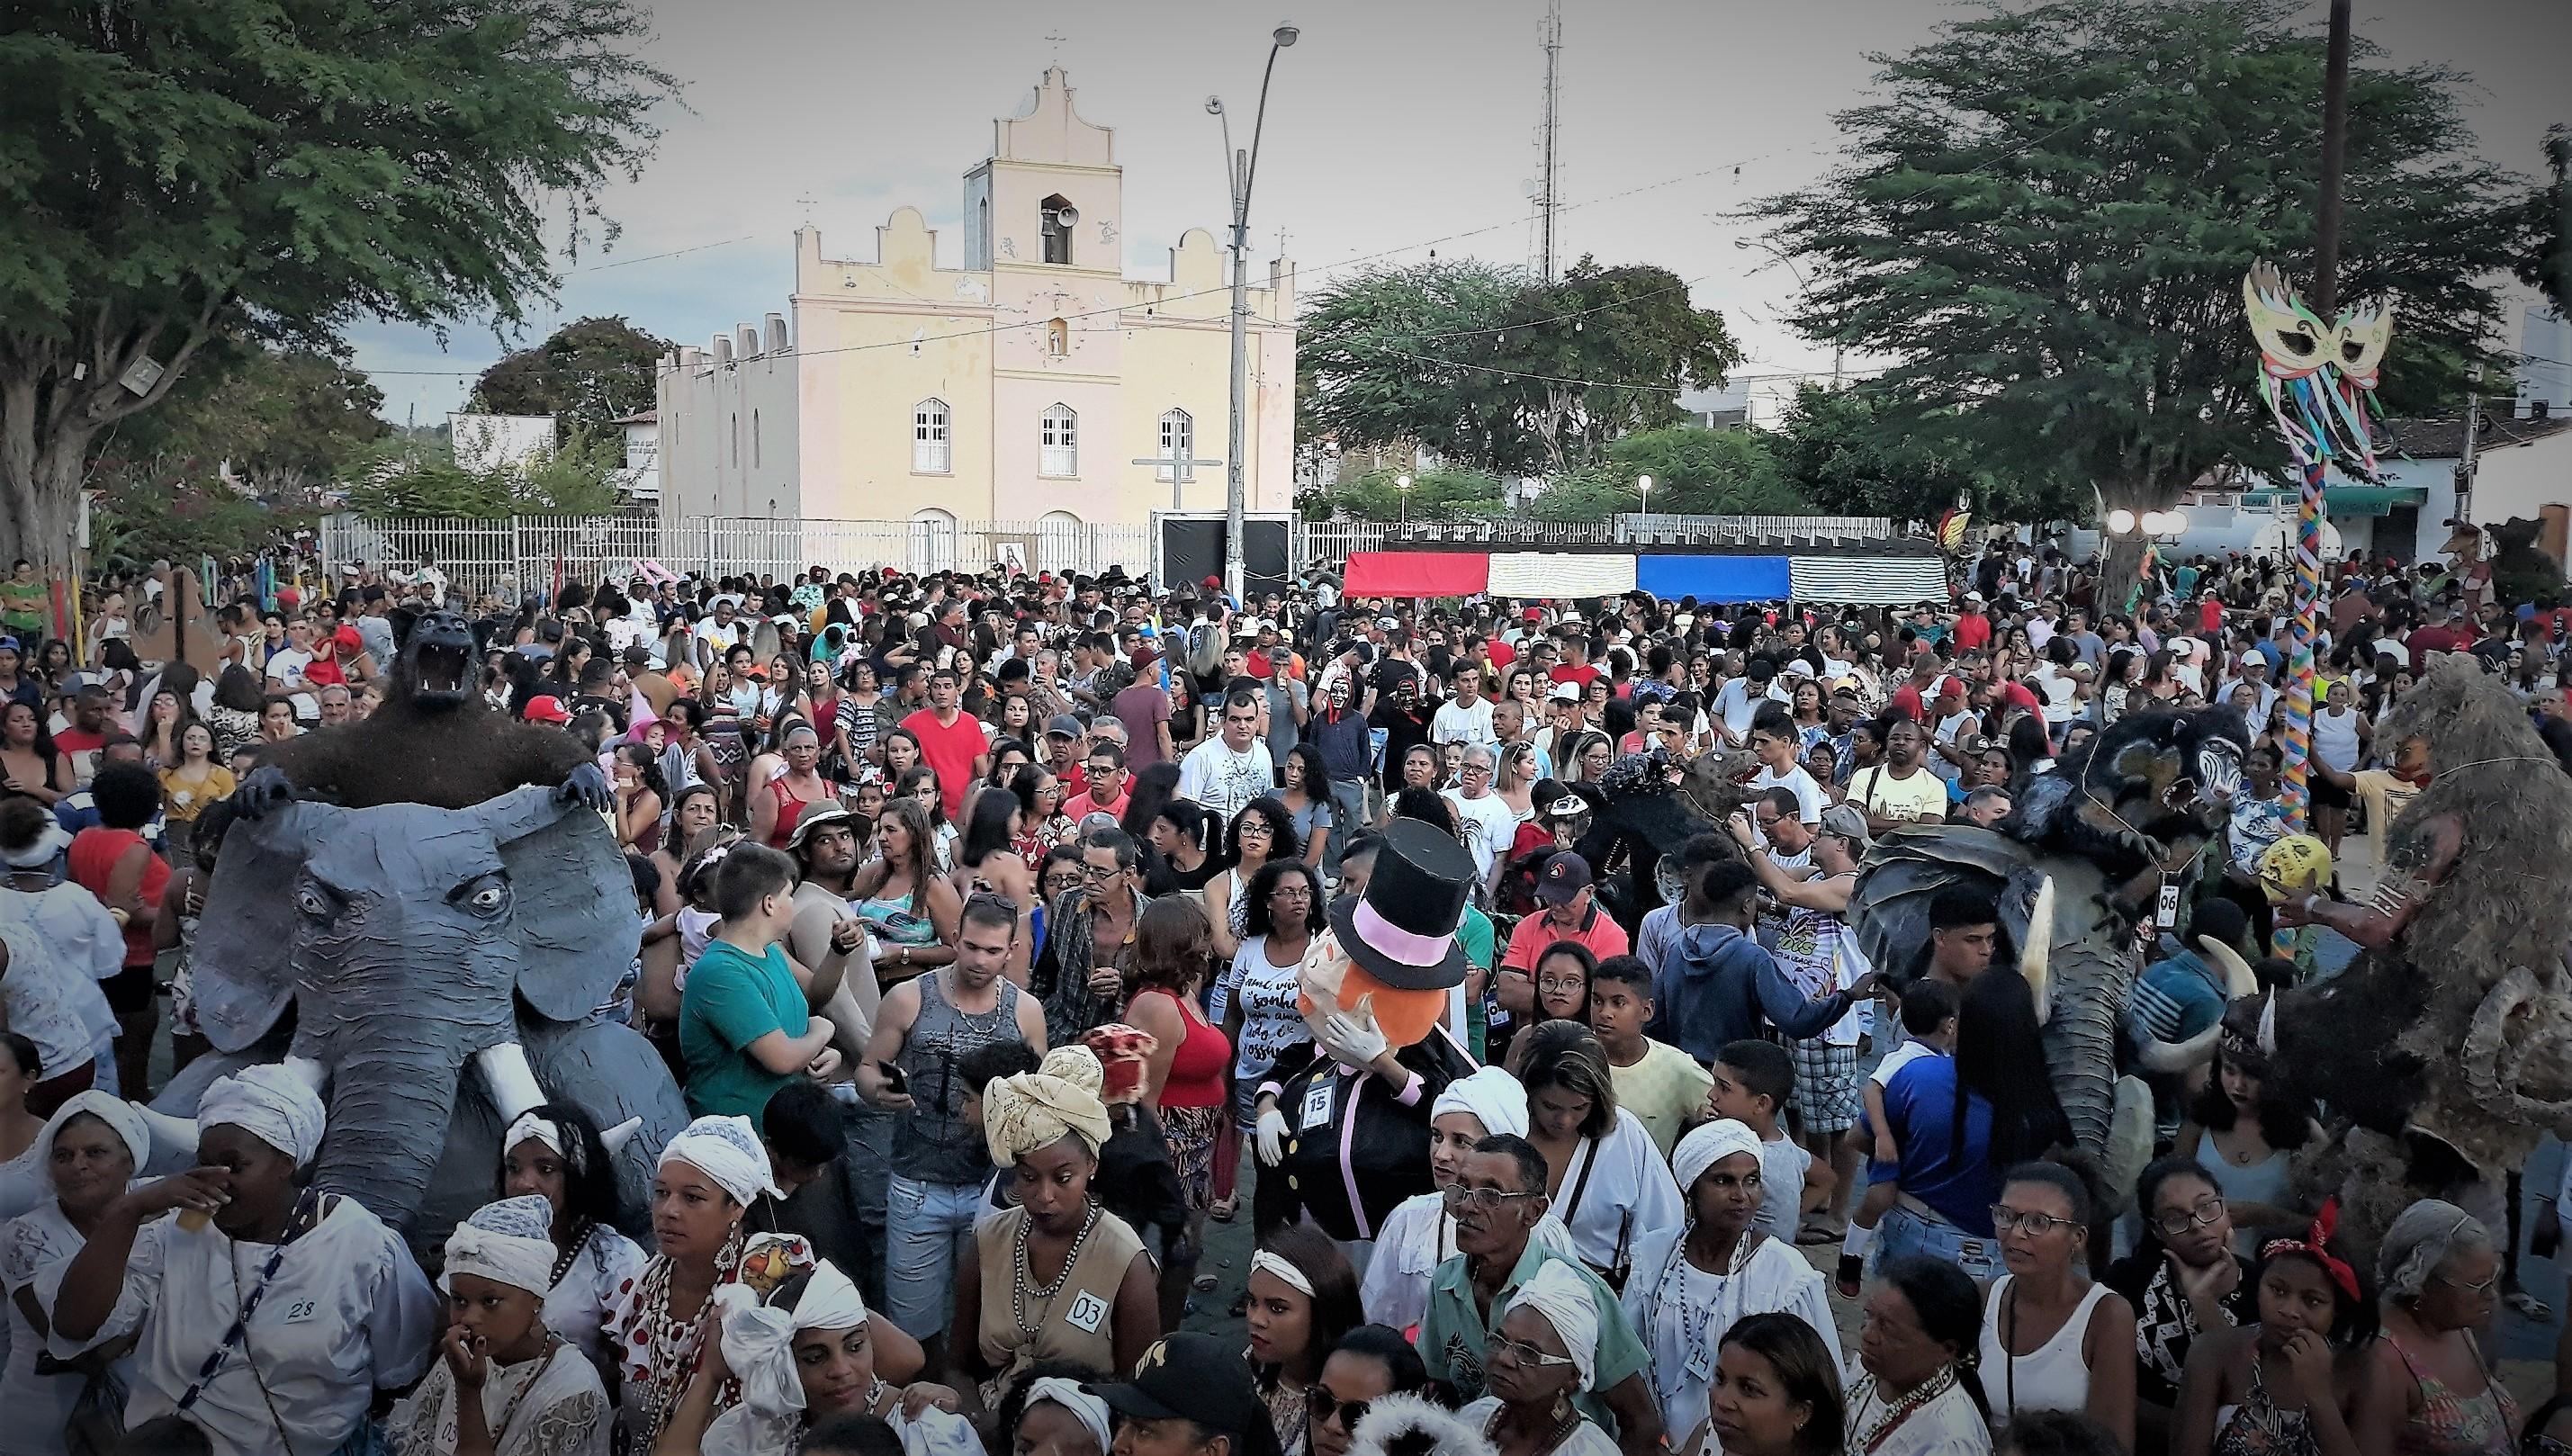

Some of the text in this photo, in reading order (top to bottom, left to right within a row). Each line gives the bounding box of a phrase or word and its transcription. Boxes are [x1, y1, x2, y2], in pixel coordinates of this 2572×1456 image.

[2160, 894, 2175, 910] 06
[1274, 1011, 1305, 1024] amo
[1310, 1096, 1326, 1112] 15
[288, 1301, 315, 1319] 28
[1074, 1297, 1101, 1325] 03
[1690, 1347, 1709, 1372] 14
